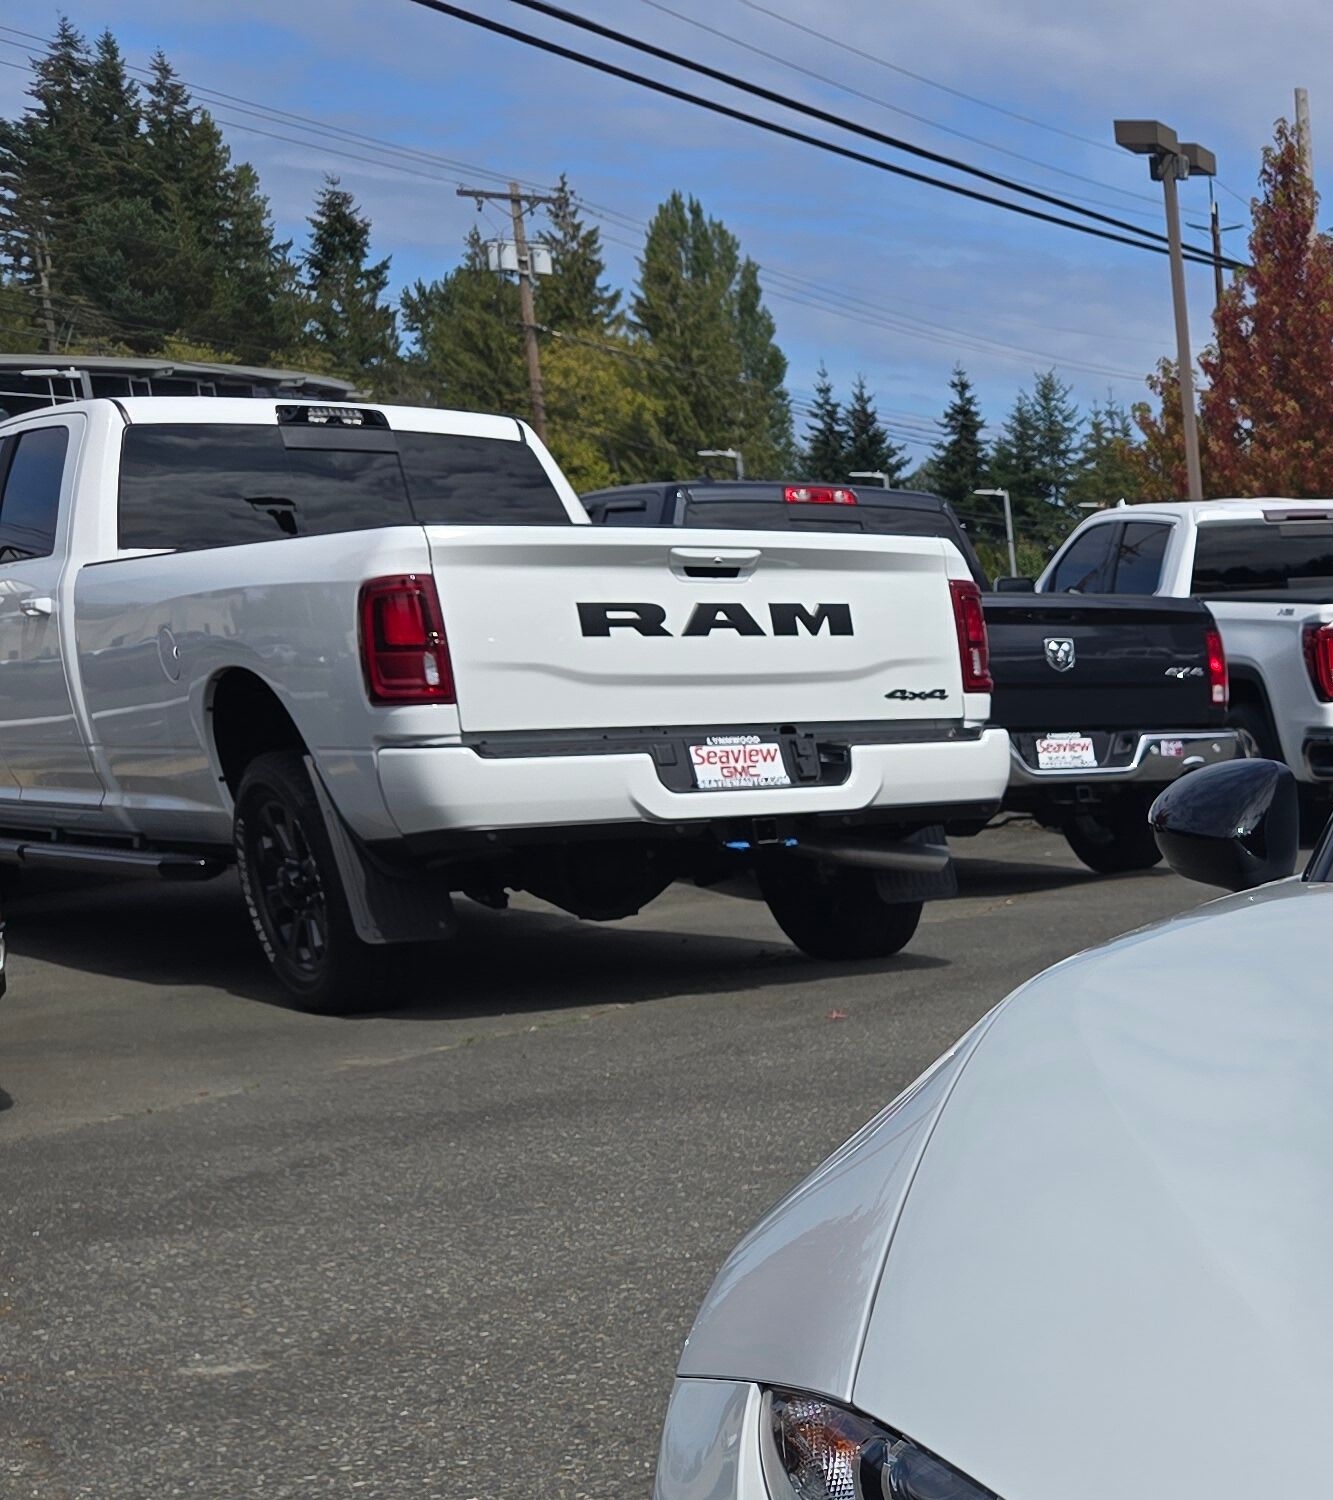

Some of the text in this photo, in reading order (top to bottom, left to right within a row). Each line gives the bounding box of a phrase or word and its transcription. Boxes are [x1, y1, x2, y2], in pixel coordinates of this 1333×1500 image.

[575, 602, 854, 637] RAM
[884, 688, 949, 701] 4x4
[694, 745, 778, 765] Seaview
[721, 765, 760, 778] GMC
